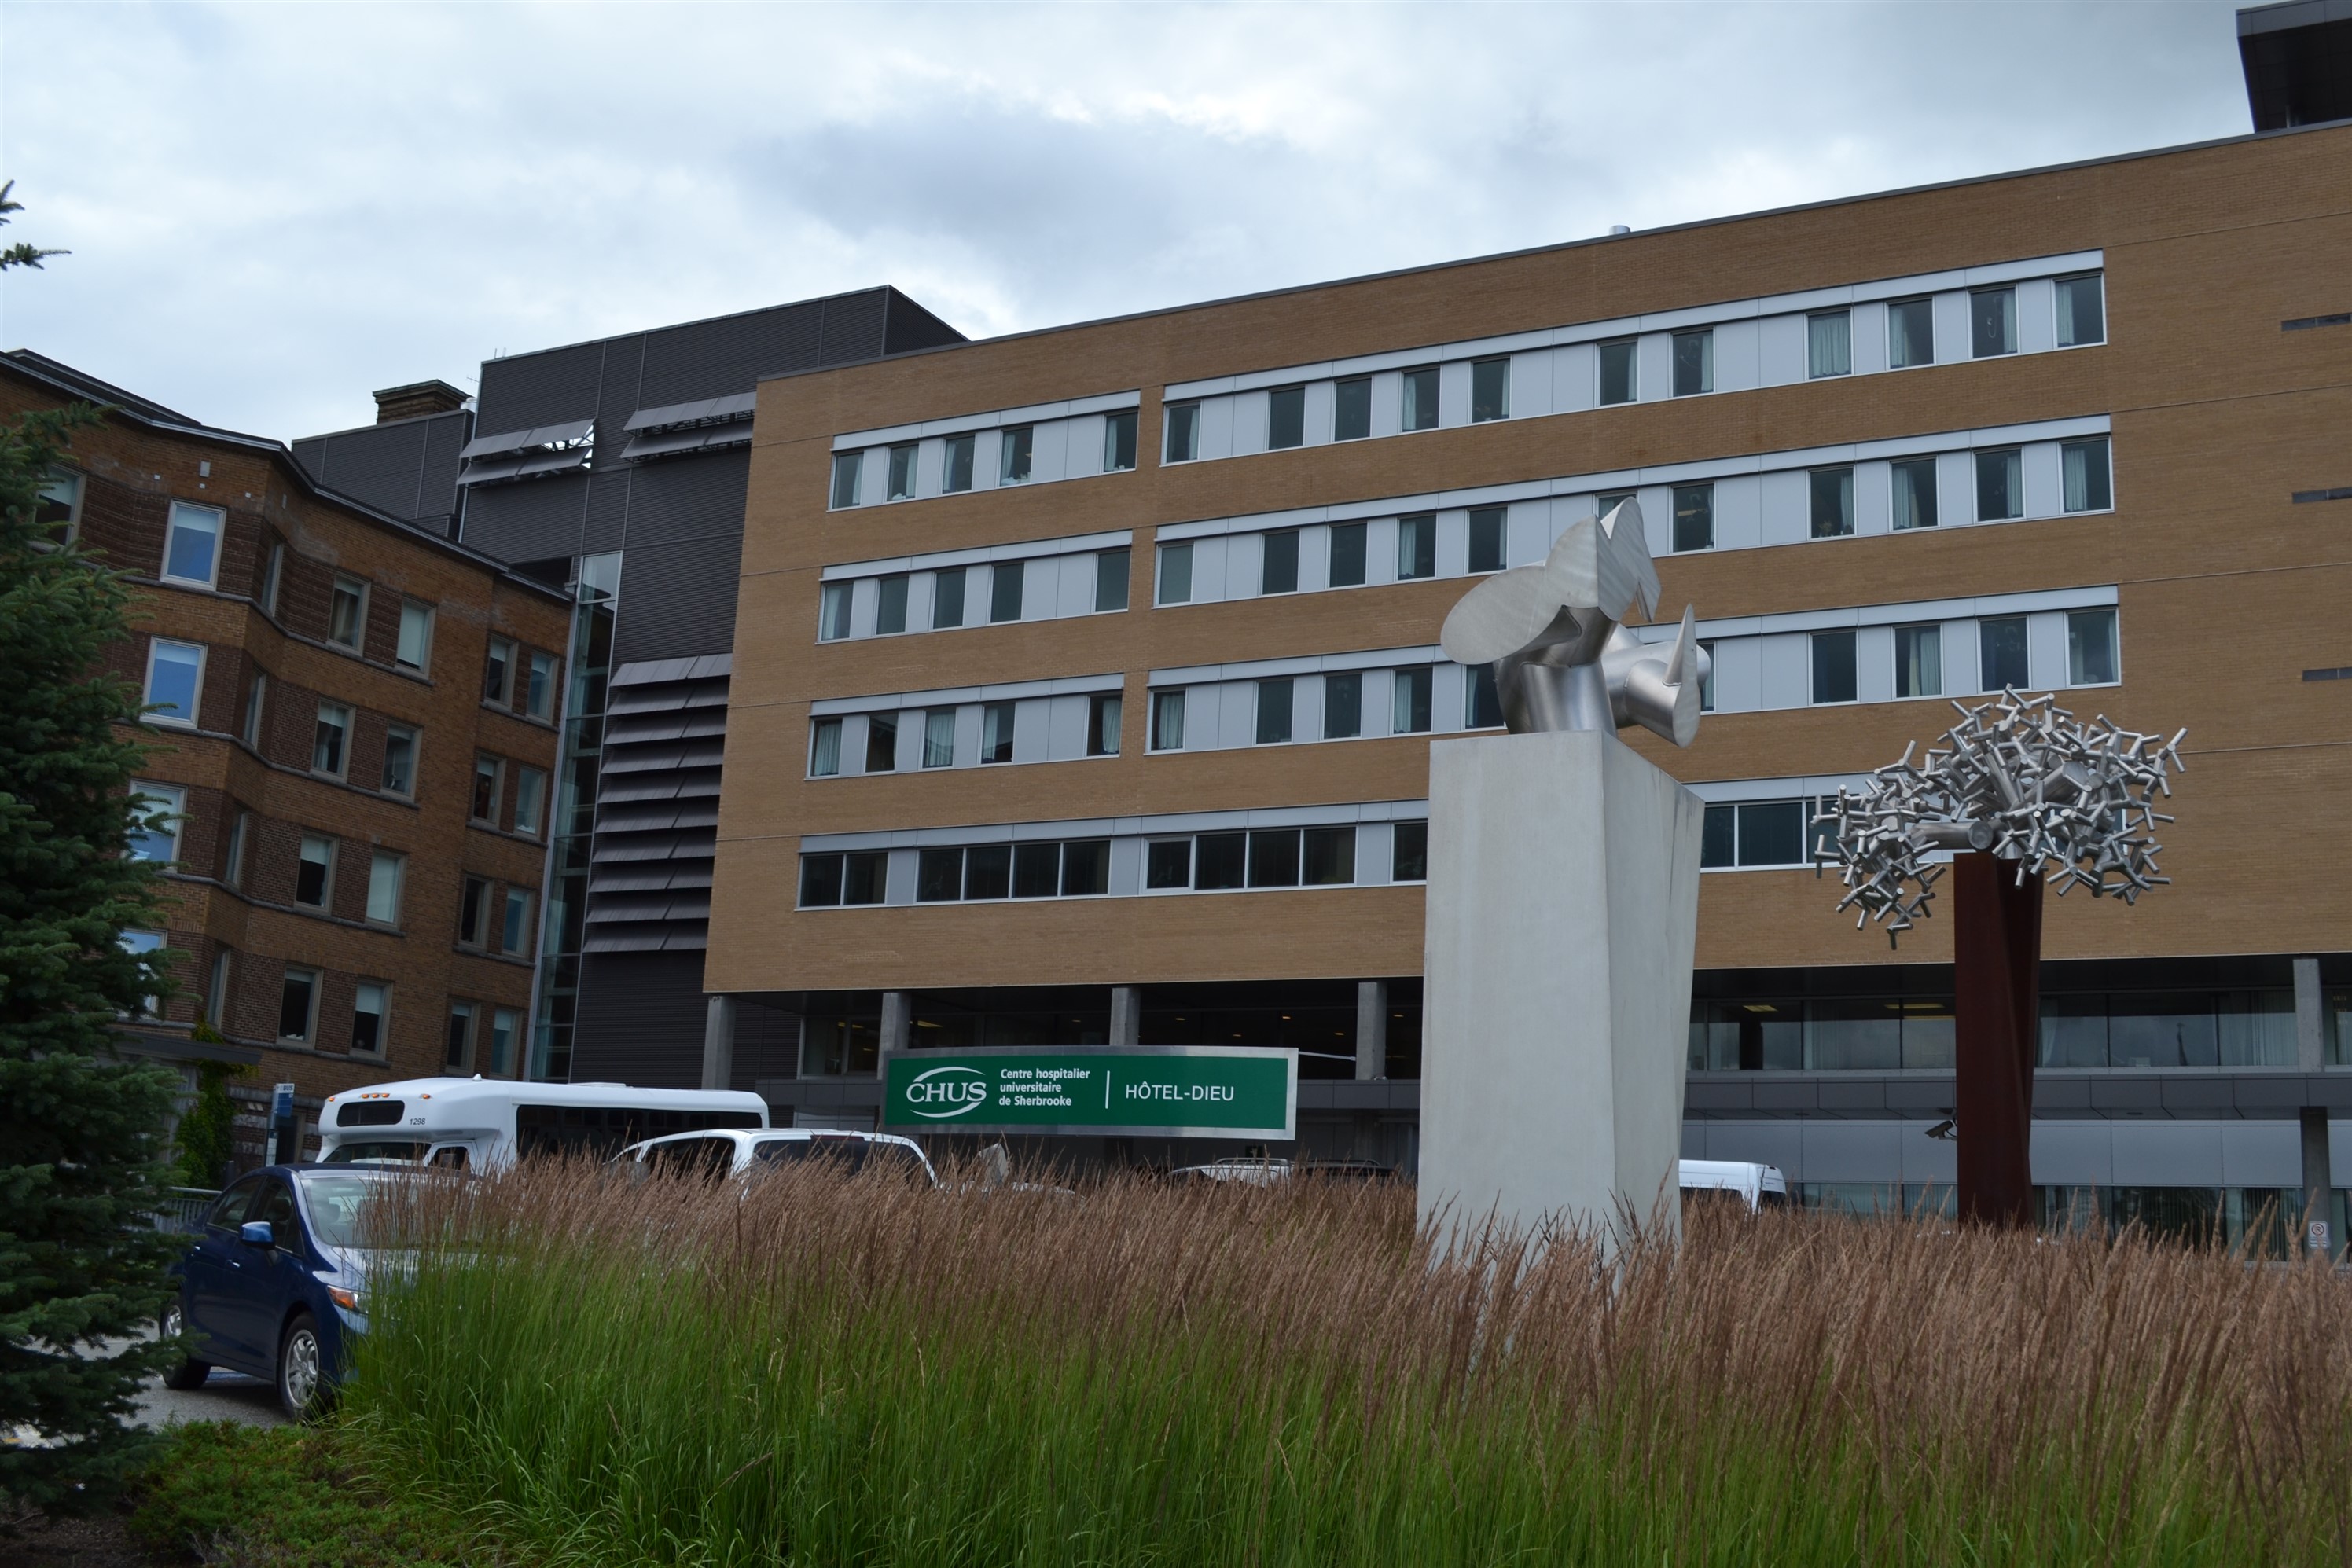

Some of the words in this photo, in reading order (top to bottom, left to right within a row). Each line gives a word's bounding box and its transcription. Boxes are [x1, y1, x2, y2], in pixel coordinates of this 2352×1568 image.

[1001, 1068, 1033, 1079] Centre
[1035, 1067, 1091, 1081] hospitalier
[906, 1081, 987, 1103] CHUS
[999, 1081, 1062, 1092] universitaire
[1125, 1081, 1235, 1102] HÔTEL-DIEU
[998, 1095, 1012, 1106] de
[1013, 1095, 1072, 1106] Sherbrooke
